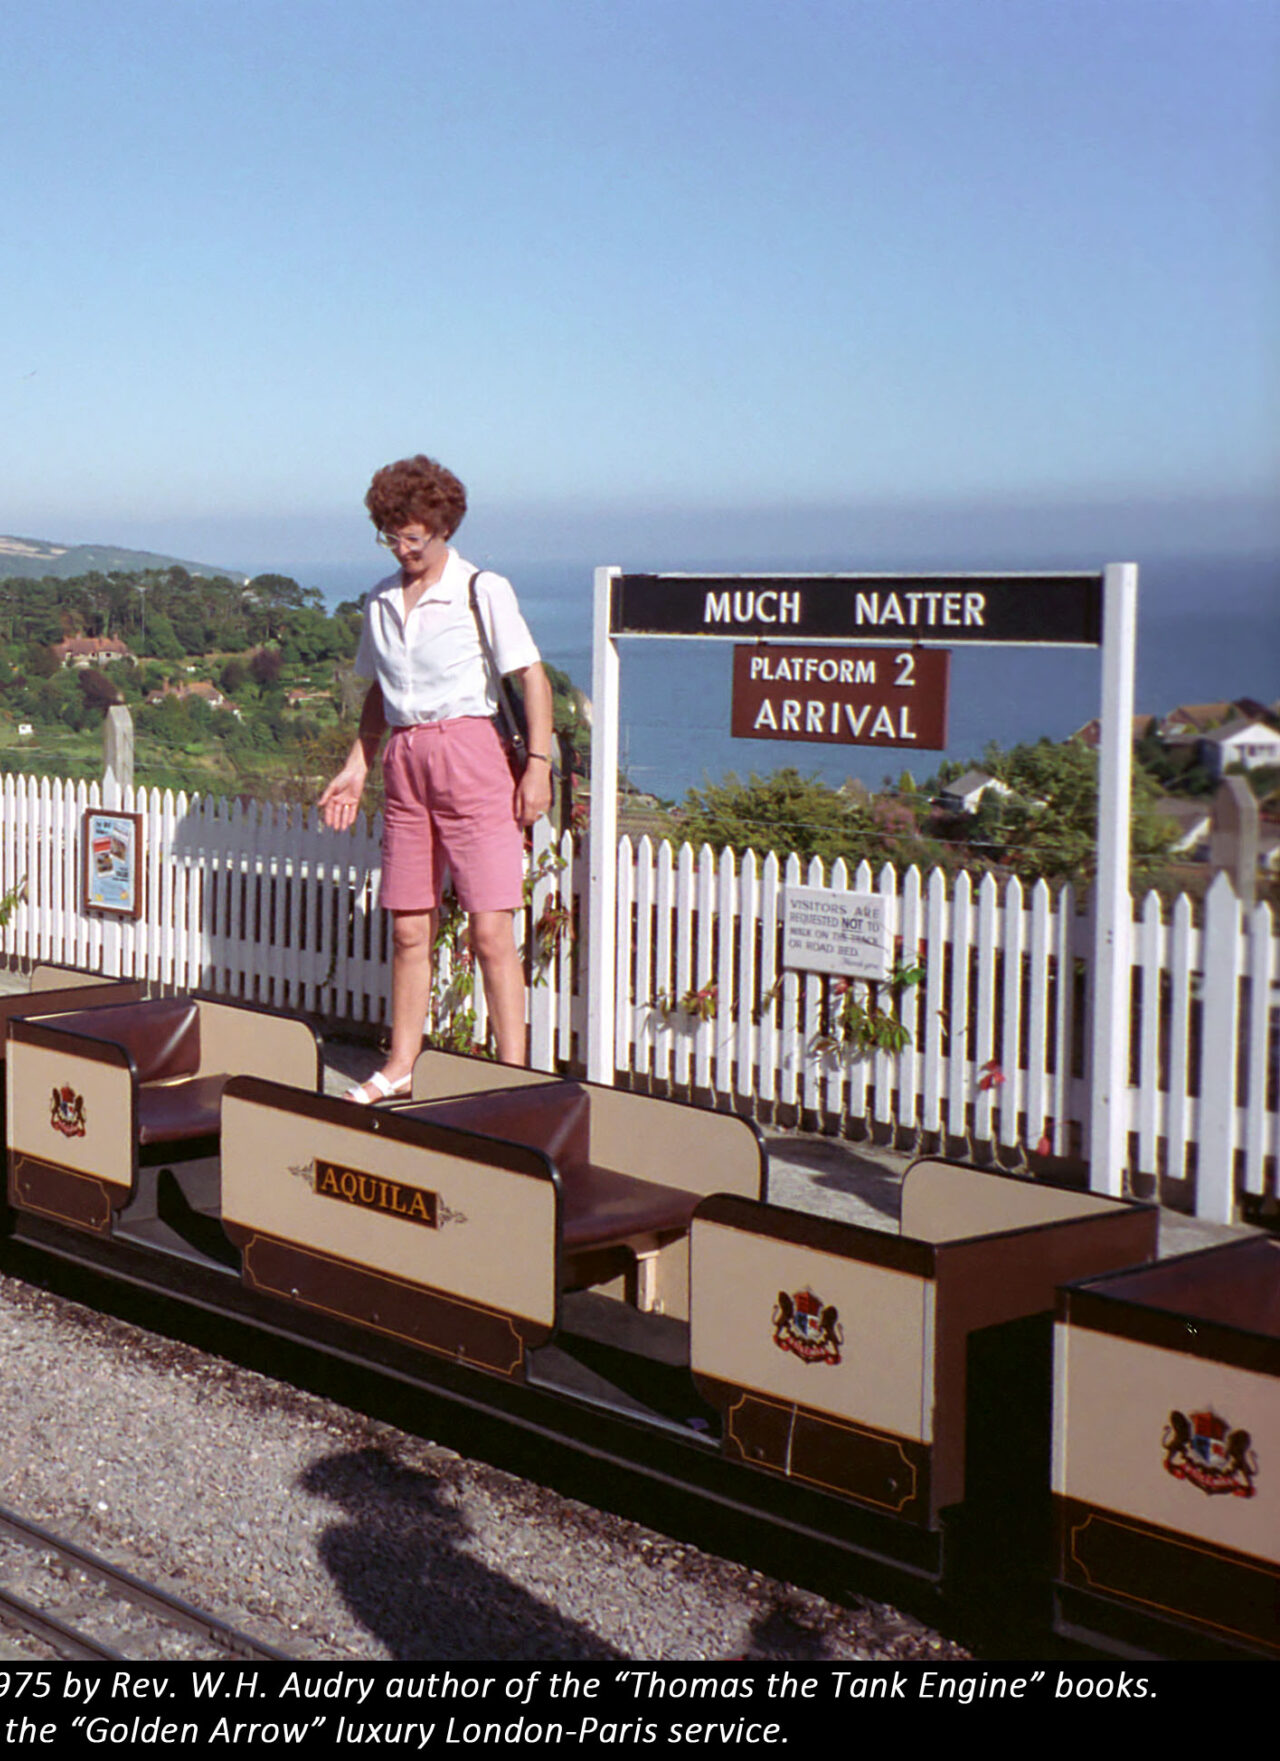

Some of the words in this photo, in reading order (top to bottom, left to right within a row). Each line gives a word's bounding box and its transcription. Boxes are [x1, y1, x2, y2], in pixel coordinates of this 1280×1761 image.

[704, 591, 800, 623] MUCH
[855, 592, 986, 626] NATTER
[750, 657, 876, 684] PLATFORM
[894, 653, 916, 686] 2
[754, 699, 916, 739] ARRIVAL
[790, 899, 847, 914] VISITORS
[854, 906, 880, 919] ARE
[790, 912, 839, 927] REQUESTED
[842, 918, 864, 930] NOT
[867, 921, 880, 932] TO
[788, 939, 801, 949] OR
[806, 942, 834, 953] ROAD
[815, 929, 828, 939] ON
[320, 1167, 431, 1220] AQUILA
